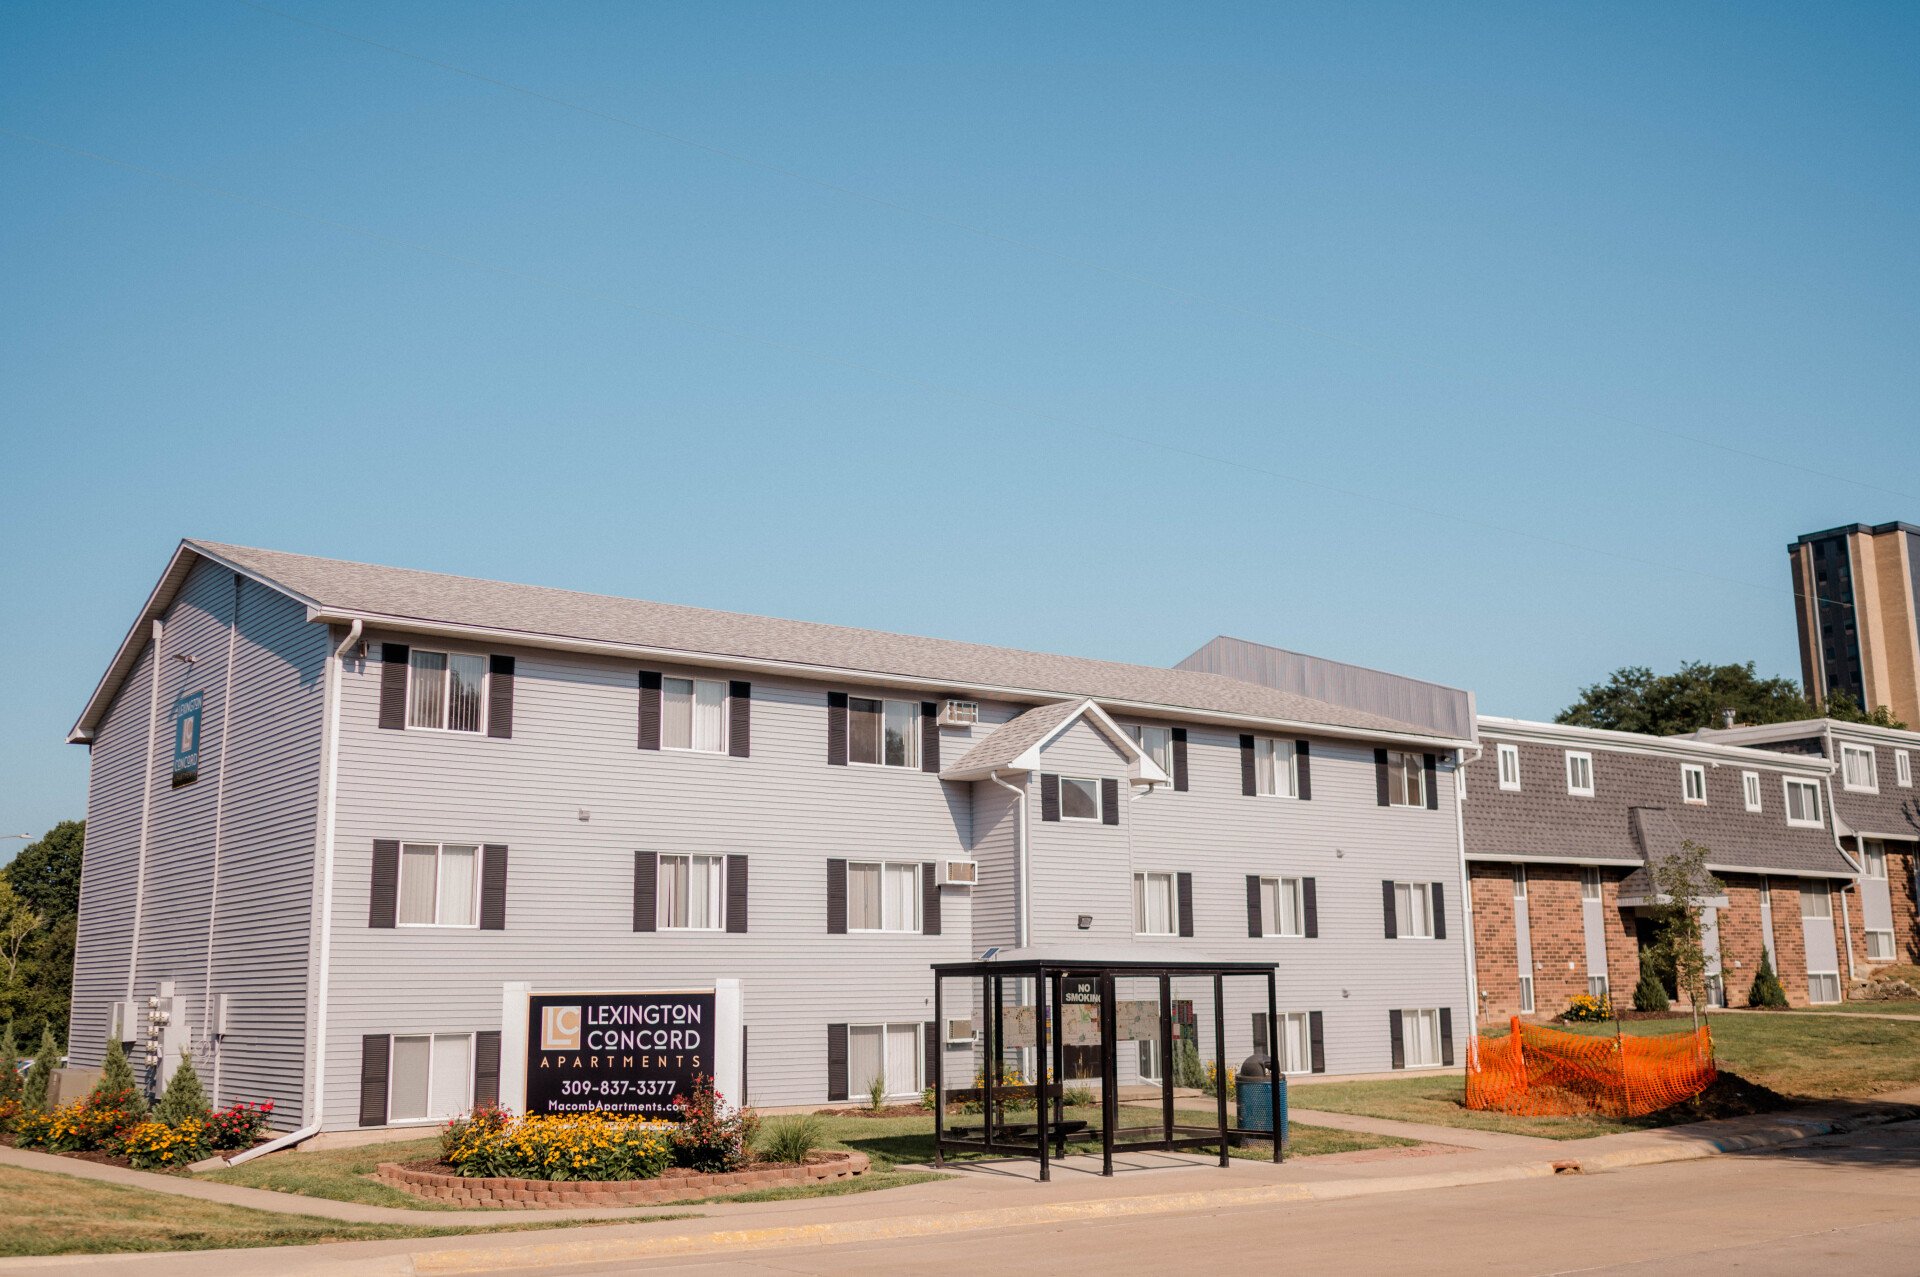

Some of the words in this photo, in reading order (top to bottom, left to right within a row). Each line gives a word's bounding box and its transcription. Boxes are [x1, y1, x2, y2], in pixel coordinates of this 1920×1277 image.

[1078, 984, 1090, 993] NO
[587, 1004, 701, 1025] LEXINGTON
[546, 1007, 580, 1045] LC
[587, 1030, 701, 1050] CONCORD
[540, 1055, 701, 1068] APARTMENTS
[561, 1080, 677, 1095] 309-837-3377
